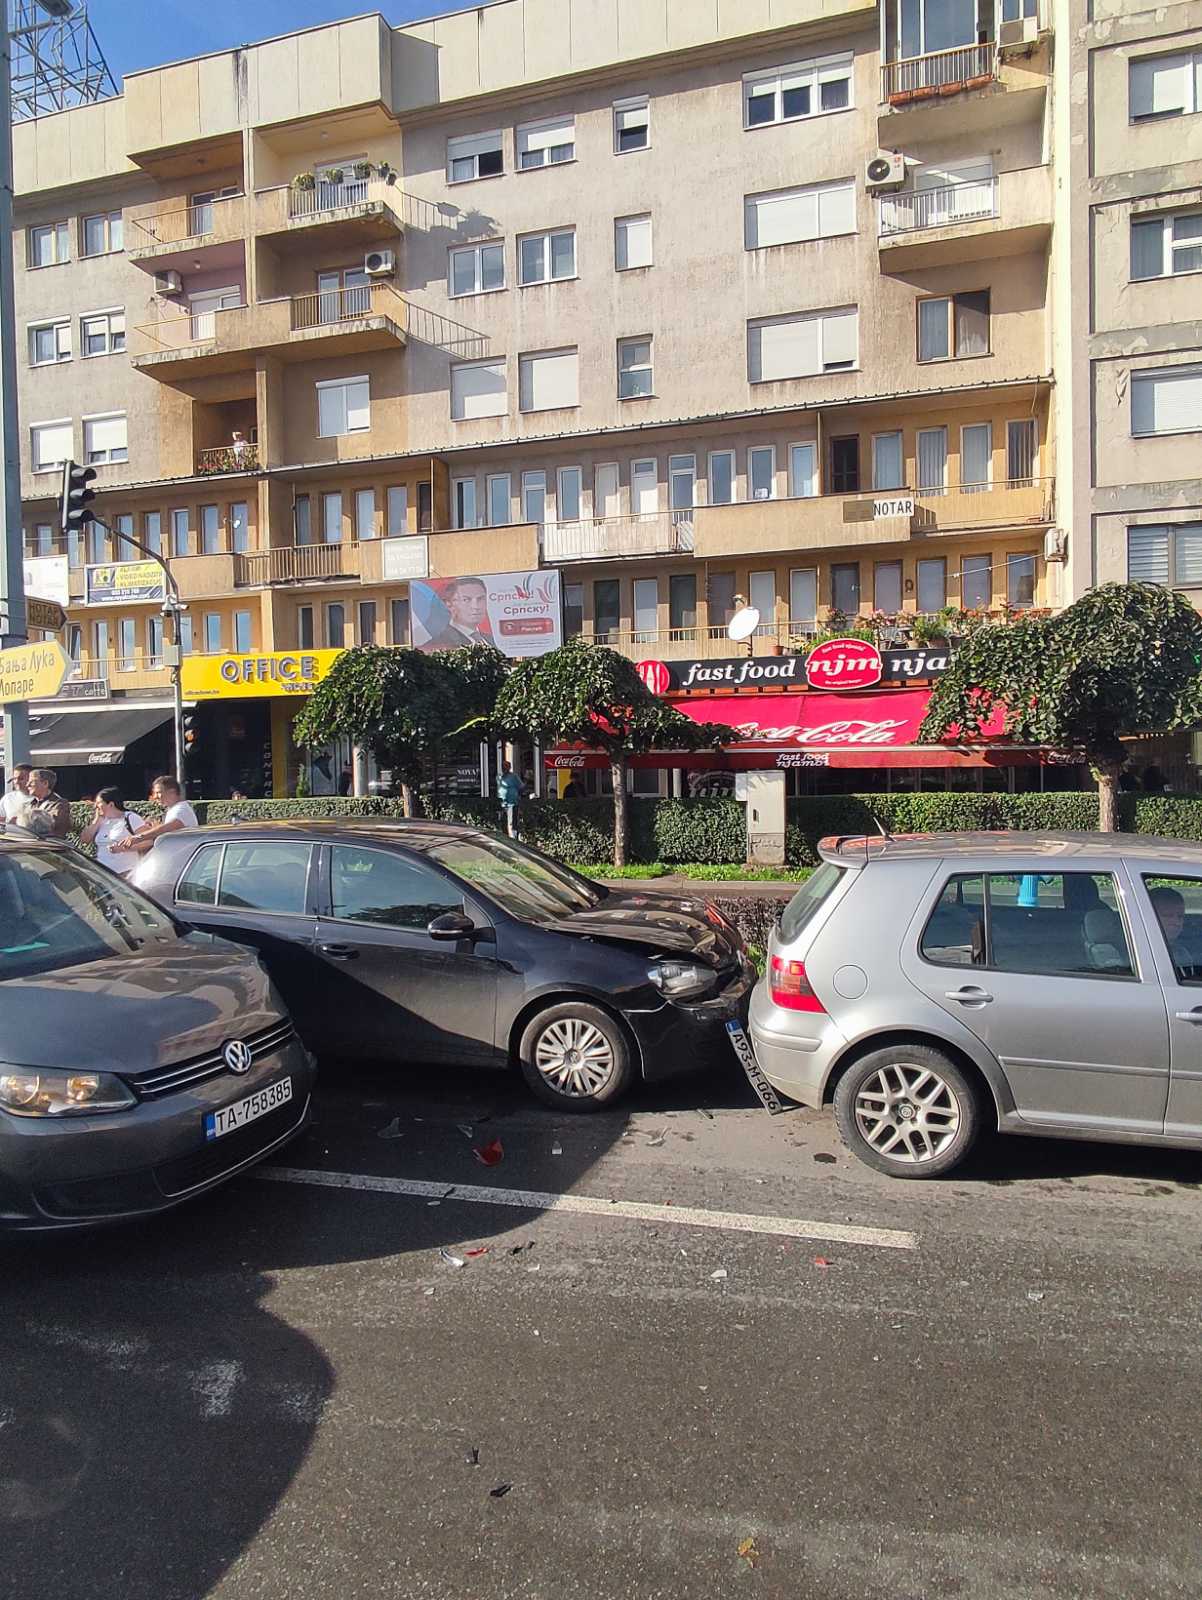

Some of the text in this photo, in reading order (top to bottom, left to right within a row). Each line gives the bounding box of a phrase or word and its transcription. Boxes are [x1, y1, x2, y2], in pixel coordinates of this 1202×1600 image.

[873, 500, 913, 516] NOTAR
[503, 603, 550, 616] Српску!
[29, 649, 55, 673] Лука
[220, 656, 316, 682] OFFICE
[682, 659, 796, 686] fast food
[809, 654, 881, 677] njm
[891, 652, 950, 676] nja
[776, 752, 830, 761] fast food
[216, 1080, 291, 1131] TA-758385
